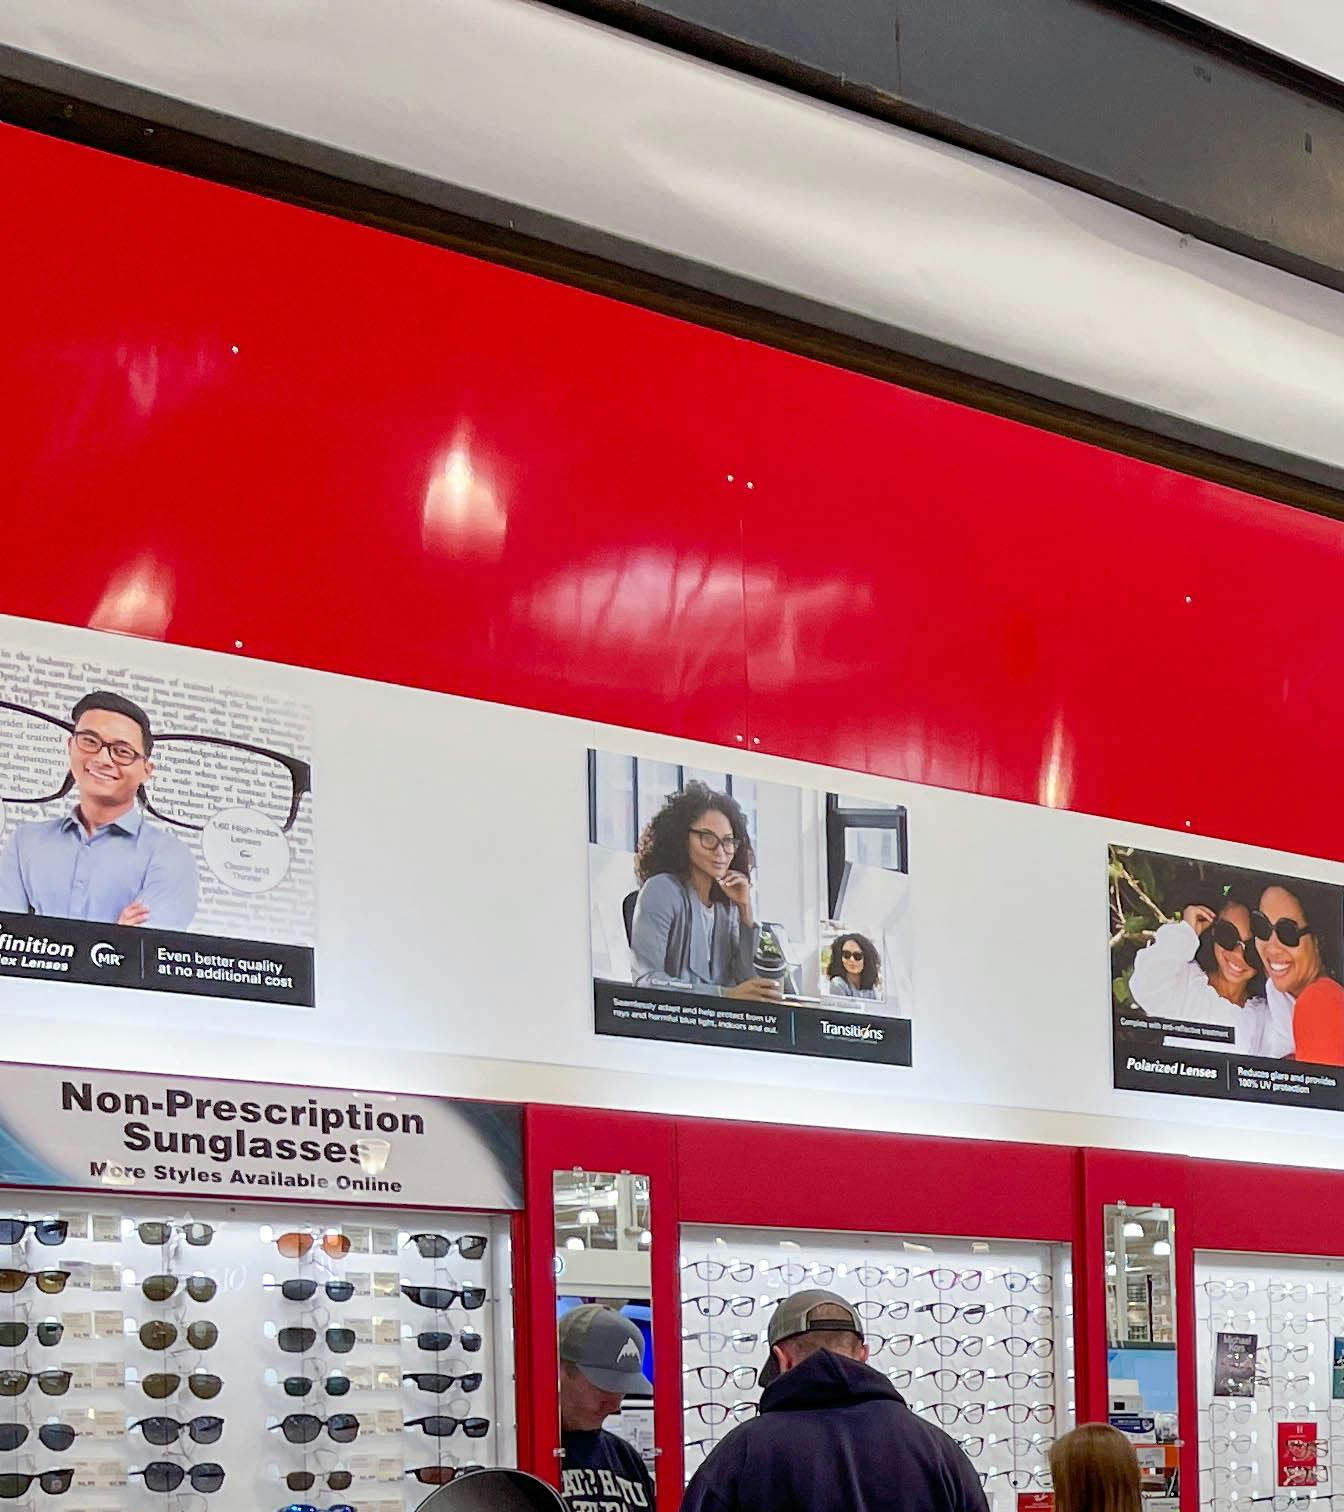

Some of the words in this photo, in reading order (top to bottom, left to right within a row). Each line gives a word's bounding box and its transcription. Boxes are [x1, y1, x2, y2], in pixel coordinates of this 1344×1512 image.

[21, 956, 69, 971] Lenses
[157, 947, 191, 962] Even
[195, 952, 234, 968] better
[237, 959, 284, 975] quality
[158, 963, 171, 976] at
[174, 966, 192, 978] no
[196, 967, 262, 986] additional
[265, 975, 293, 988] cost
[820, 1020, 884, 1040] Transitions
[1127, 1057, 1178, 1074] Polarized
[1180, 1064, 1218, 1079] Lenses
[61, 1081, 425, 1135] Non-Prescription
[123, 1121, 370, 1164] Sunglasses
[90, 1160, 146, 1180] More
[154, 1164, 223, 1185] Styles
[230, 1168, 329, 1189] Available
[336, 1174, 402, 1193] Online
